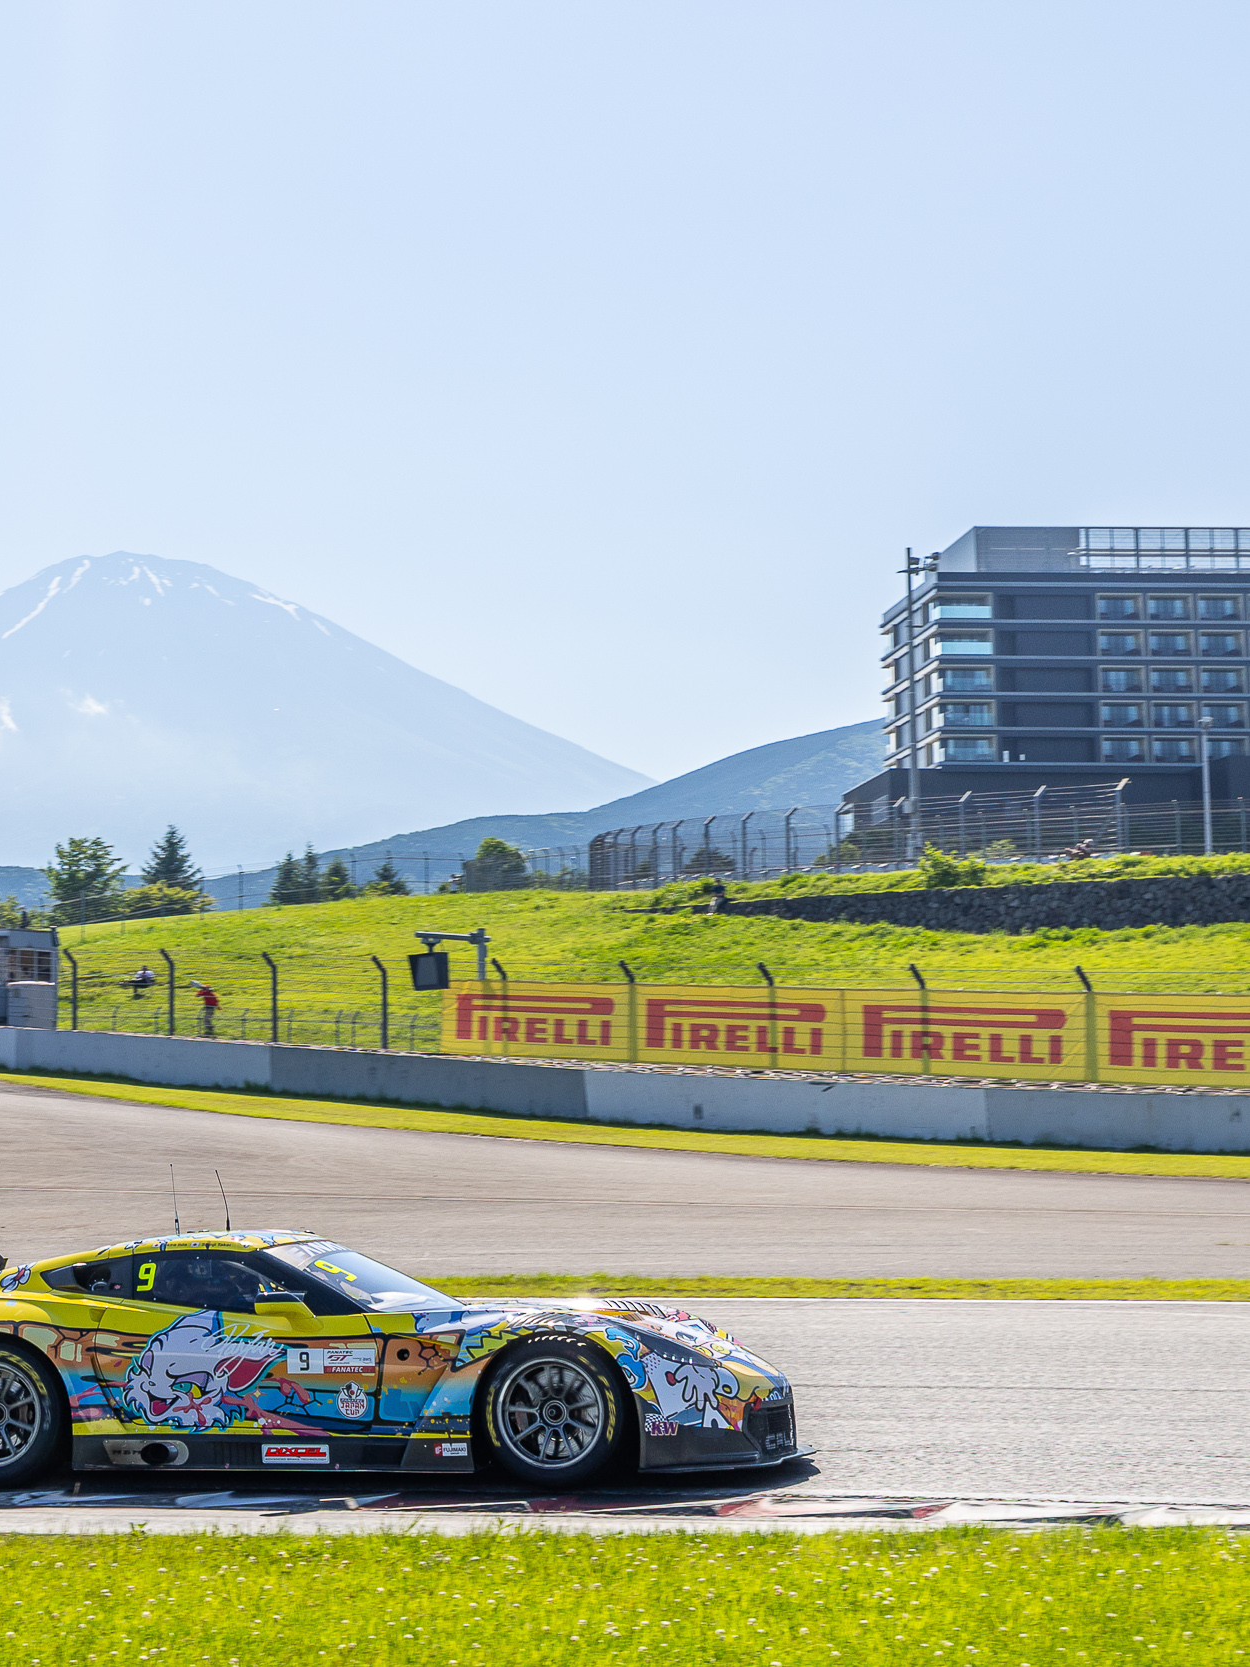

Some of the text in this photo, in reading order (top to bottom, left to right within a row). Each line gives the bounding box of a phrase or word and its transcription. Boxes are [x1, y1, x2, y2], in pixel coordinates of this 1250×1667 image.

[456, 993, 614, 1046] PIRELLI
[646, 999, 826, 1055] PIRELLI
[862, 1005, 1066, 1064] PIRELLI
[137, 1262, 157, 1292] 9
[314, 1259, 357, 1282] 9
[299, 1351, 310, 1371] 9
[340, 1401, 365, 1409] JAPAN
[651, 1420, 679, 1436] KW
[265, 1447, 327, 1457] DIXCEL
